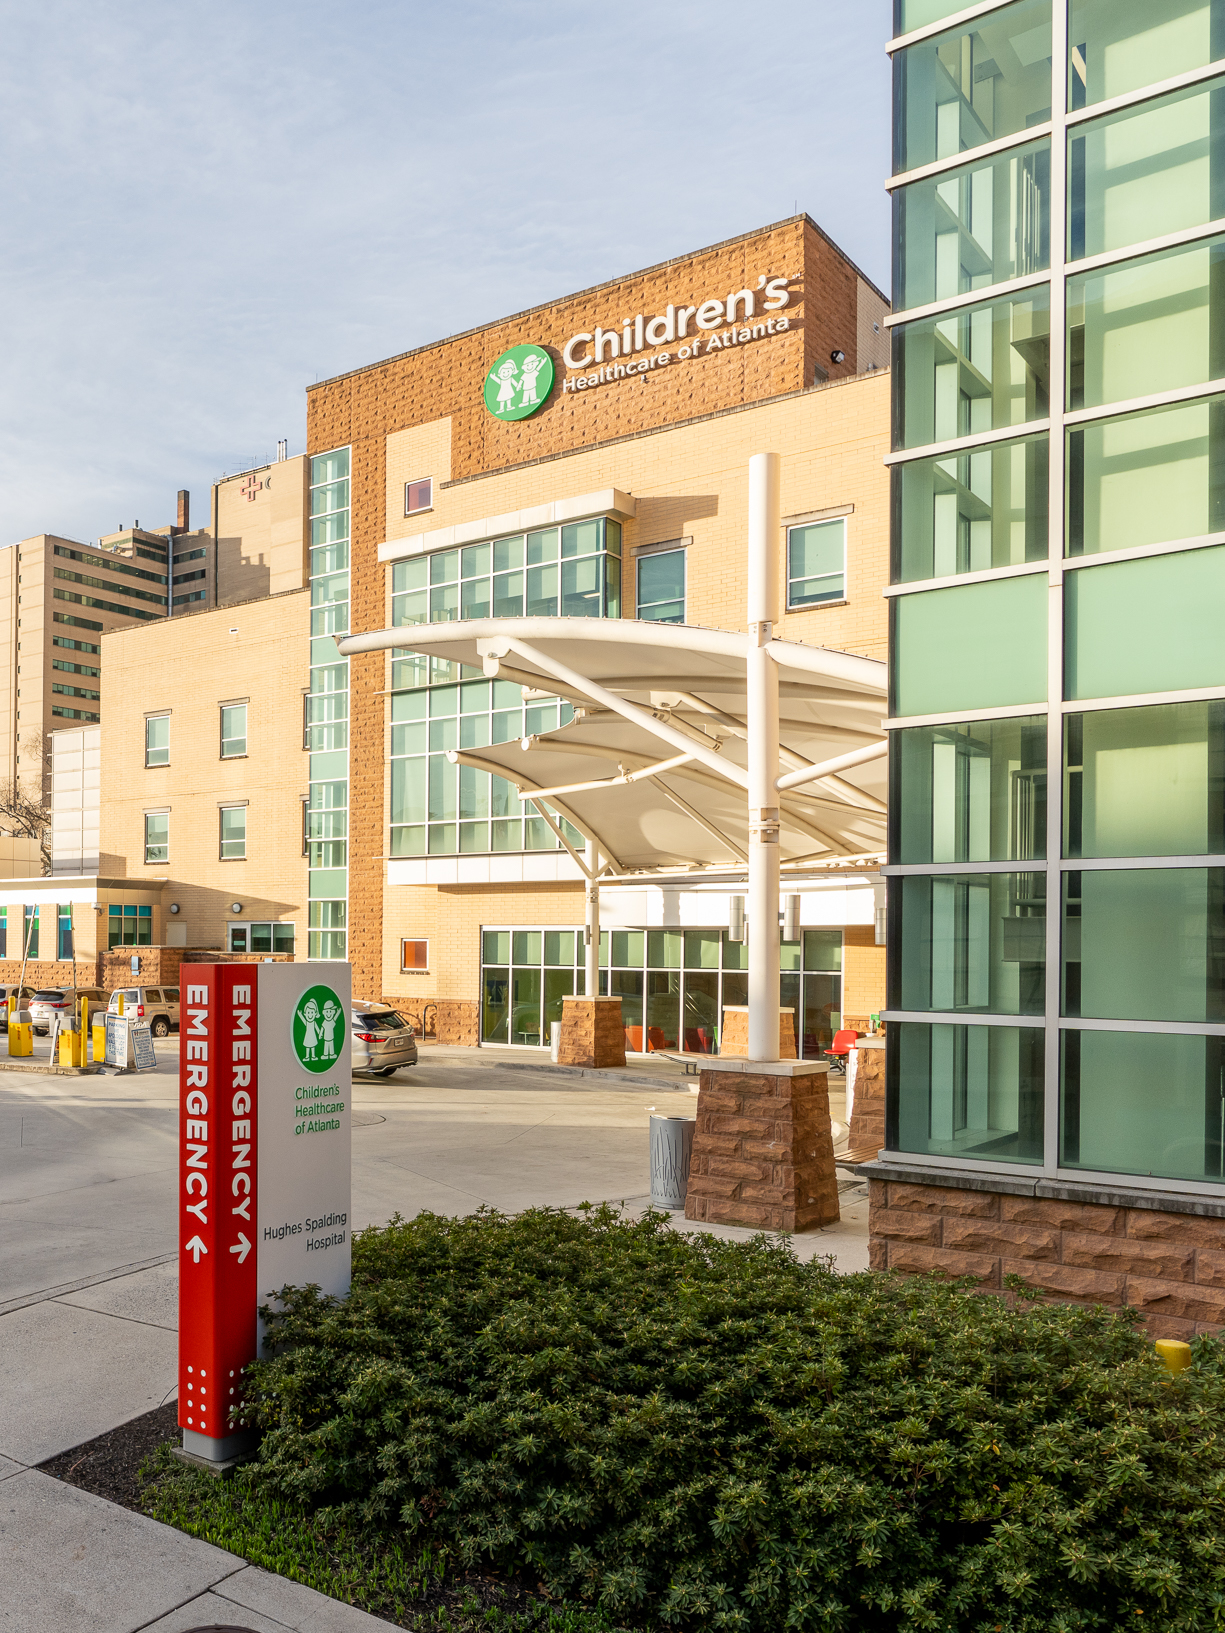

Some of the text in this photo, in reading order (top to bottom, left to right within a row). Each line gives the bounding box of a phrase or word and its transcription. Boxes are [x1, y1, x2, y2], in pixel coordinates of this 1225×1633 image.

[563, 274, 790, 370] Children's
[562, 316, 790, 394] Healthcare of Atlanta
[186, 984, 208, 1225] EMERGENCY
[232, 984, 251, 1221] EMERGENCY
[295, 1083, 340, 1100] Children's
[295, 1101, 345, 1117] Healthcare
[295, 1118, 340, 1135] of Atlanta
[264, 1212, 347, 1241] Hughes Spalding
[306, 1230, 346, 1252] Hospital
